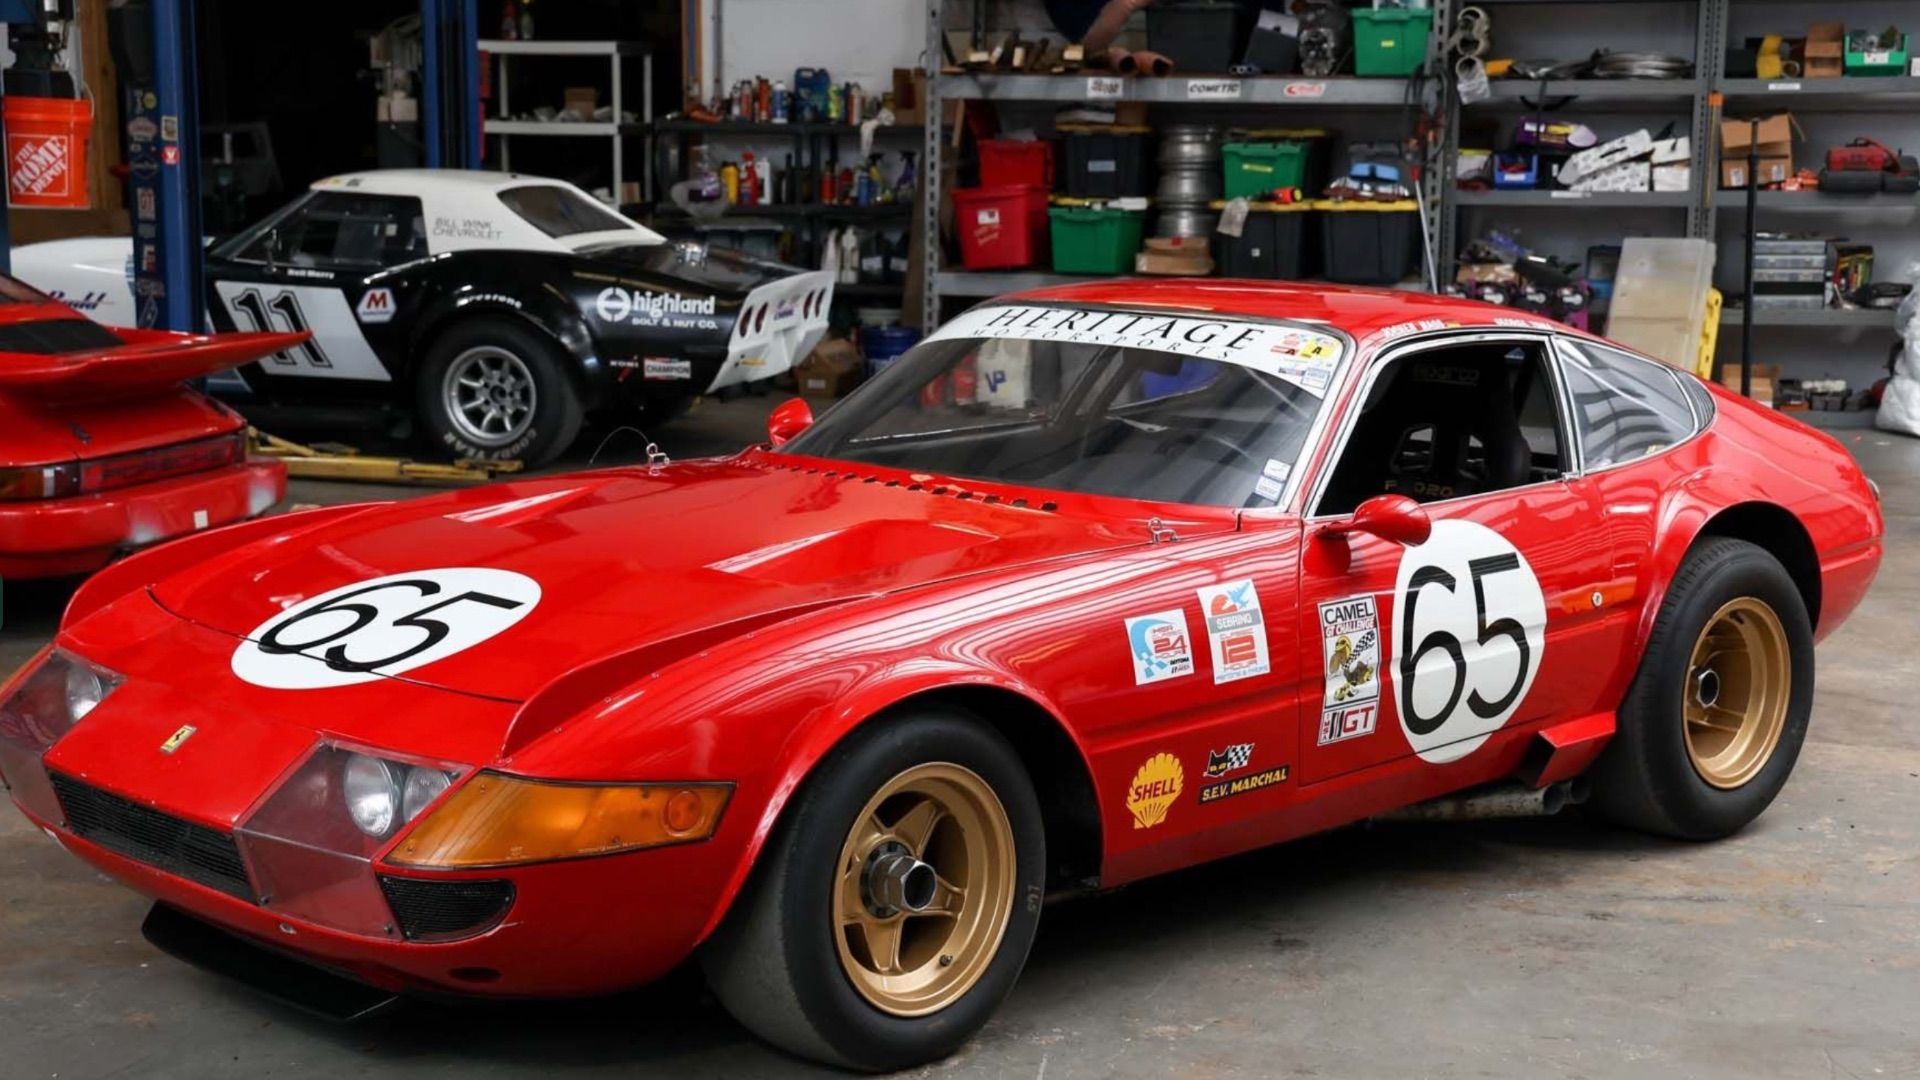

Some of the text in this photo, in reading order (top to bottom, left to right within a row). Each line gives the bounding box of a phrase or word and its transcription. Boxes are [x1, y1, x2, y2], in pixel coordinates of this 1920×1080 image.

[12, 136, 66, 193] HOME
[16, 141, 37, 165] THE
[30, 159, 67, 195] DEPOT
[633, 290, 716, 319] highland
[231, 288, 333, 369] 11
[631, 317, 719, 330] BOLT & NUT CO.
[986, 308, 1265, 351] HERITAGE
[971, 329, 1231, 360] MOTORSPORTS
[646, 364, 691, 374] CHAMPION
[985, 370, 1007, 393] VP
[258, 579, 525, 673] 65
[1216, 612, 1253, 630] SEBRING
[1324, 602, 1374, 625] CAMEL
[1326, 617, 1375, 637] GT CHALLENGE
[1152, 634, 1188, 655] 24
[1221, 635, 1257, 665] 12
[1400, 552, 1530, 735] 65
[1343, 705, 1375, 733] GT
[1133, 777, 1176, 802] SHELL
[1202, 767, 1288, 801] S.E.V. MARCHAL
